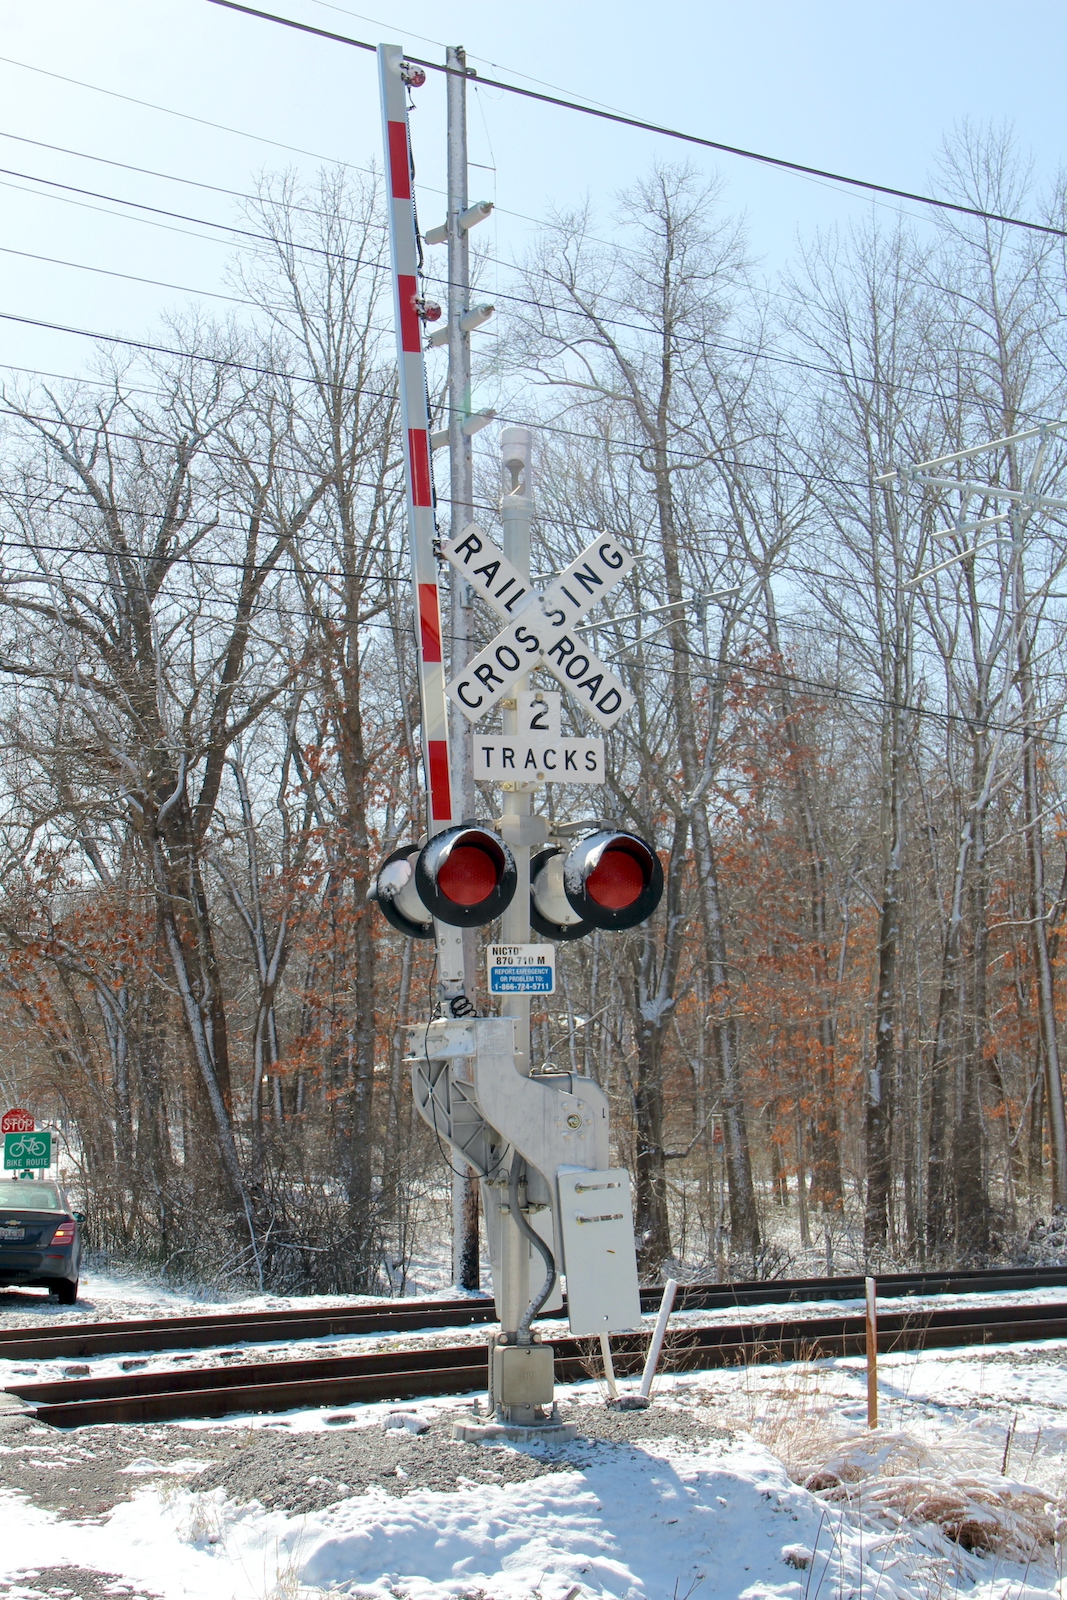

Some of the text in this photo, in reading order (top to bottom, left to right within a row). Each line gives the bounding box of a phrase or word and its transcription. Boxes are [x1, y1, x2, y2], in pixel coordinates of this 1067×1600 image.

[454, 533, 622, 715] RAIL ROAD
[457, 543, 624, 709] CROSSING
[530, 699, 549, 730] 2
[482, 746, 597, 772] TRACKS
[496, 956, 545, 965] 870 710 M
[3, 1118, 33, 1131] STOP
[6, 1158, 48, 1167] BIKE ROUTE
